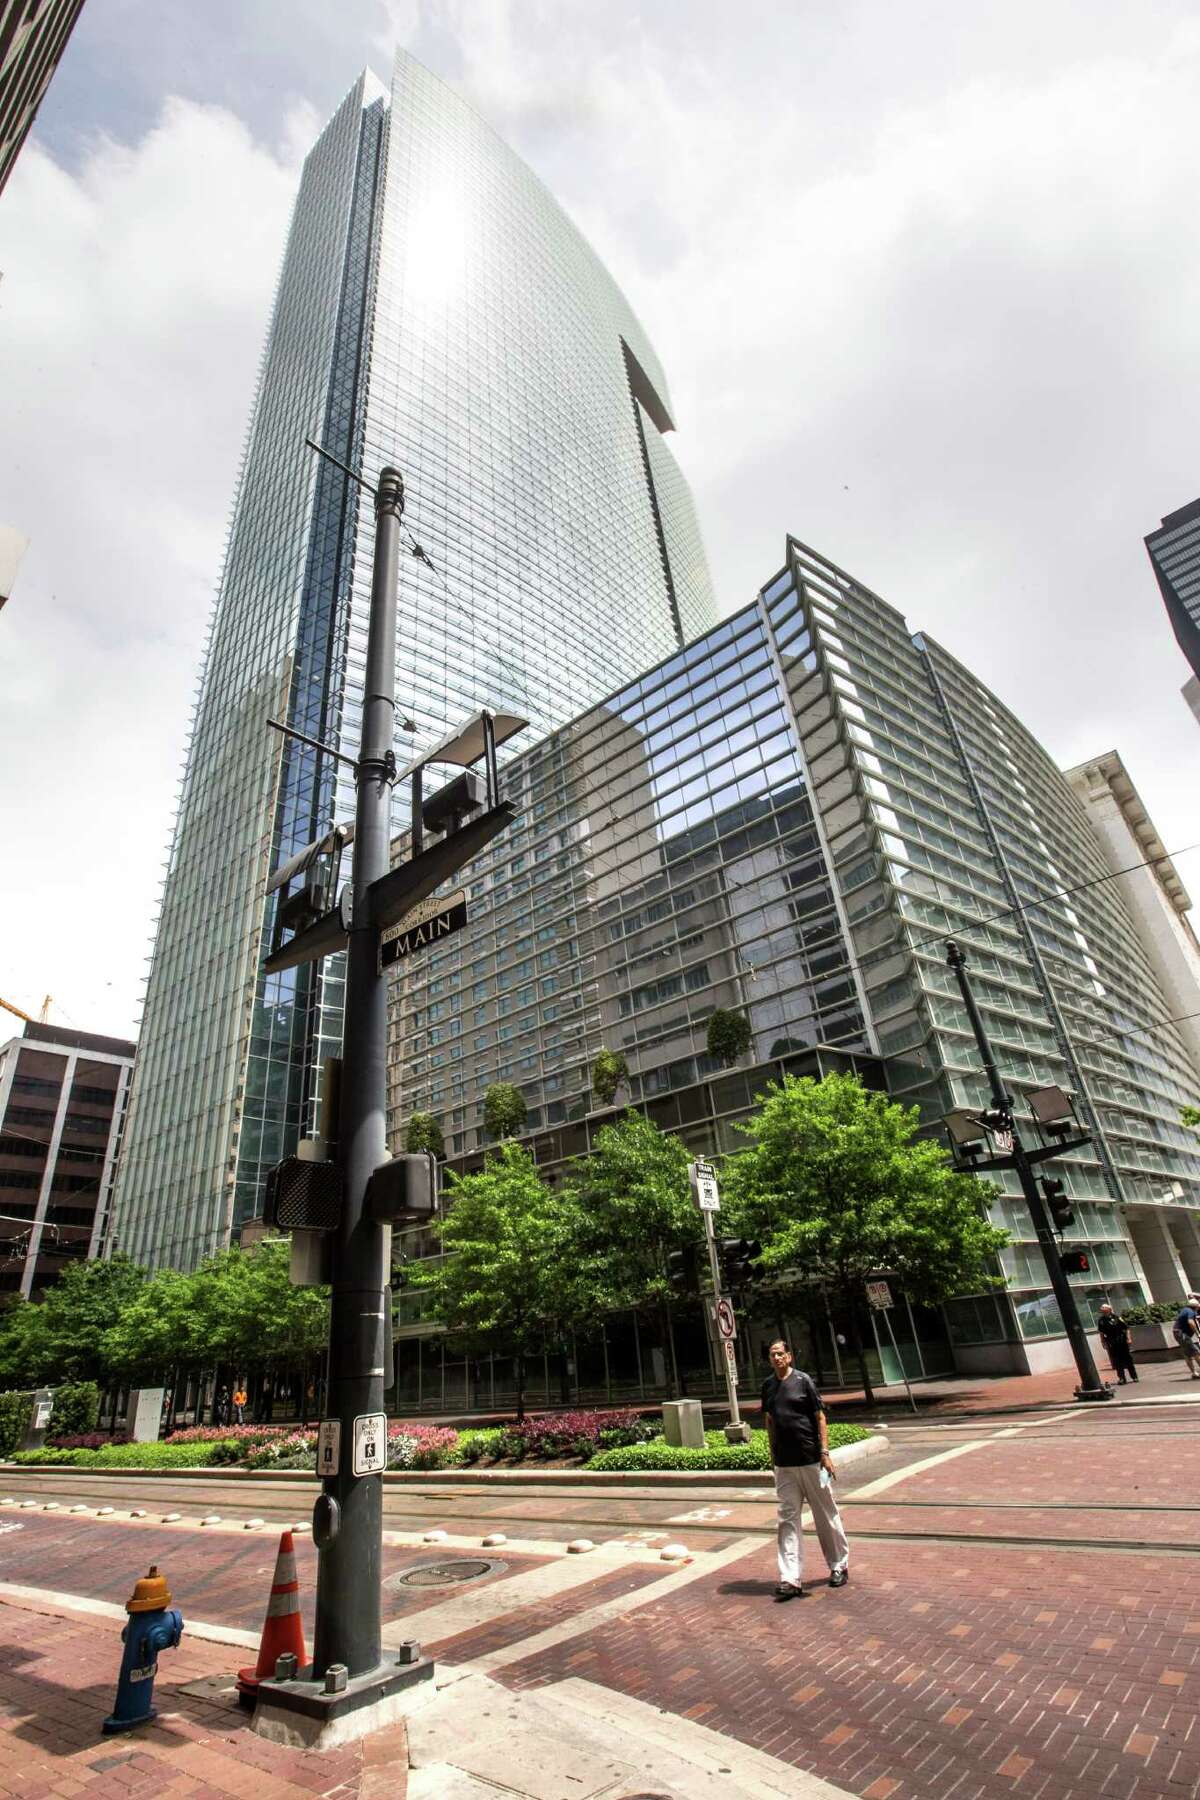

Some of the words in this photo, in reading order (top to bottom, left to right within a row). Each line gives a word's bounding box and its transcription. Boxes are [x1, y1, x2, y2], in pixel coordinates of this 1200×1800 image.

[395, 912, 451, 957] MAIN
[698, 1164, 712, 1173] TRAIN
[1080, 1255, 1088, 1270] 2
[361, 1422, 379, 1431] CROSS
[360, 1458, 380, 1467] SIGNAL
